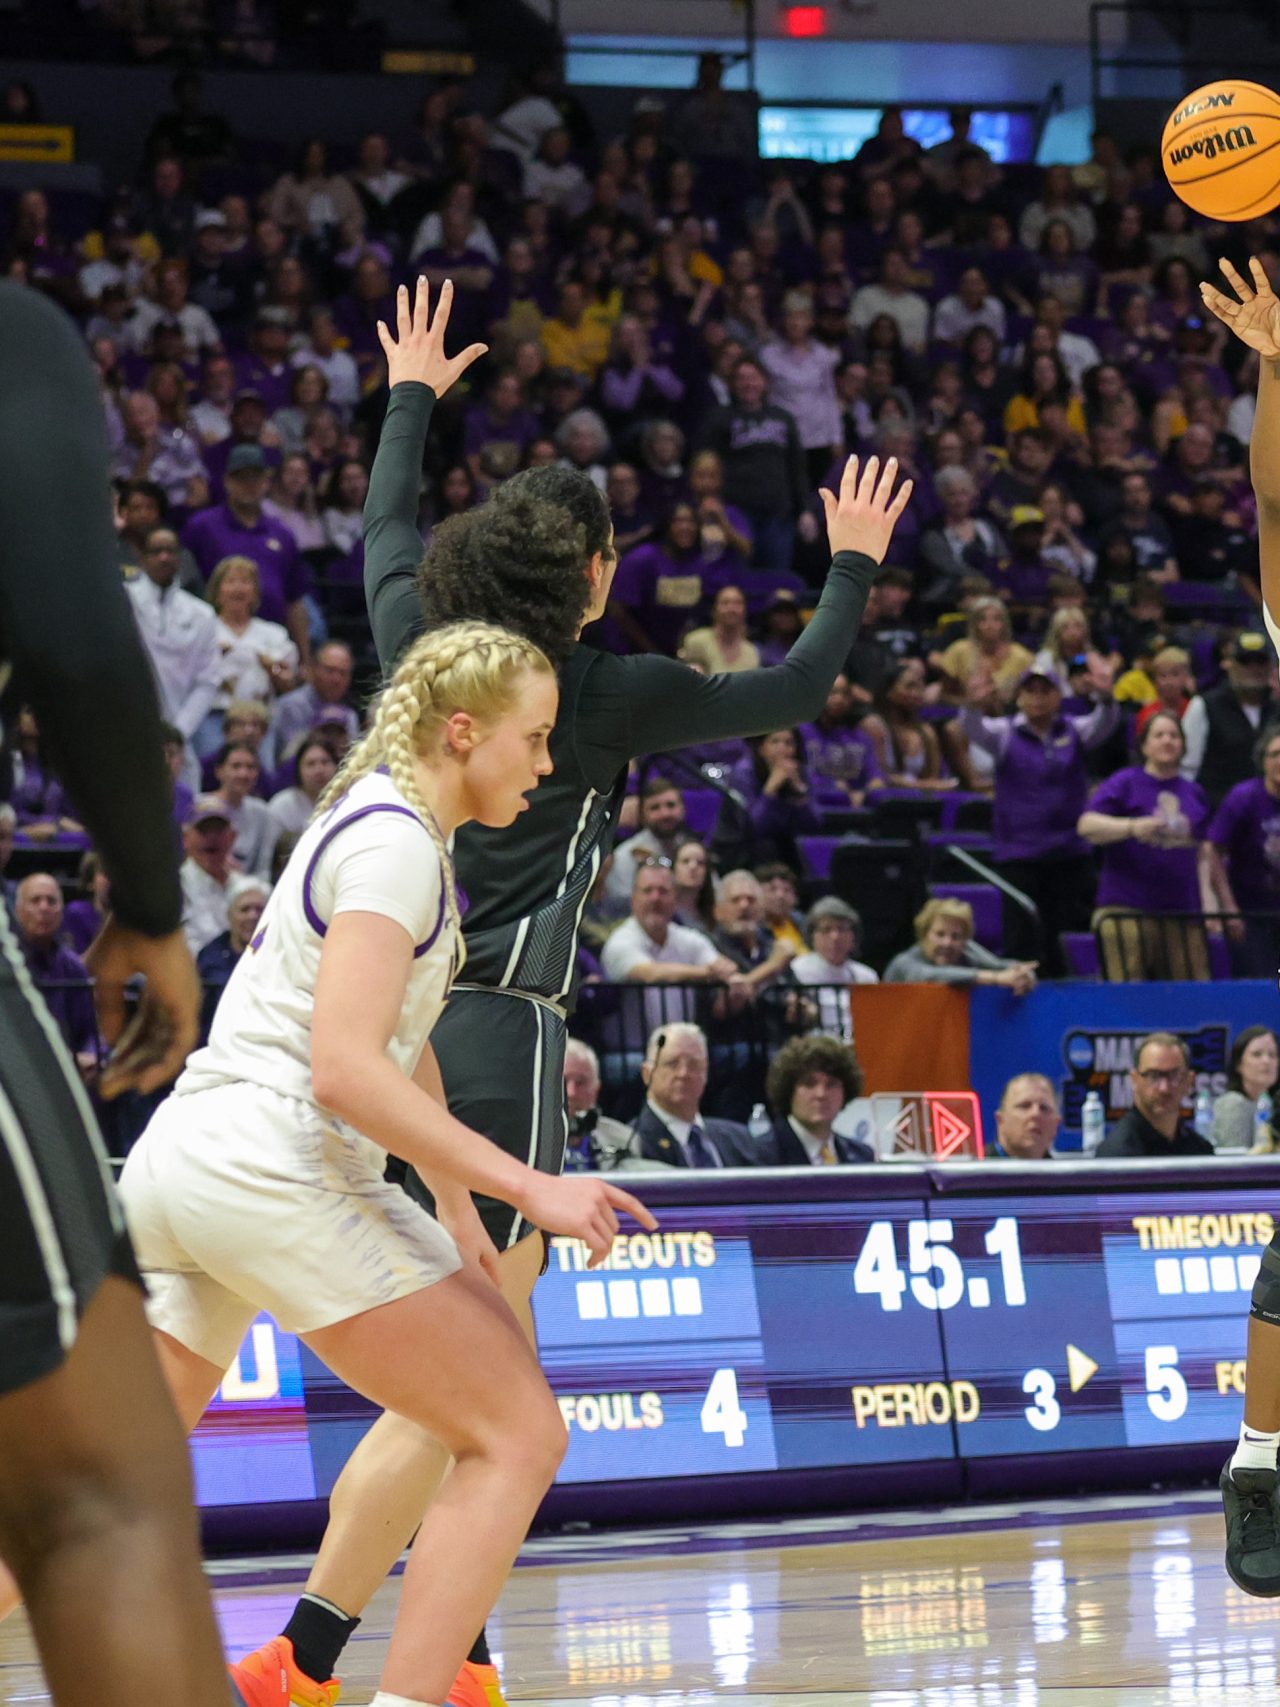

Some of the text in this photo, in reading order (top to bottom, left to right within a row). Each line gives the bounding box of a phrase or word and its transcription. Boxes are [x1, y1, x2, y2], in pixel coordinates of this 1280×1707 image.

[1169, 125, 1257, 166] Wilson
[853, 1216, 1027, 1312] 45.1
[1132, 1213, 1275, 1250] TIMEOUTS
[700, 1367, 748, 1447] 4
[851, 1368, 1061, 1432] PERIOD 3
[1145, 1345, 1188, 1422] 5
